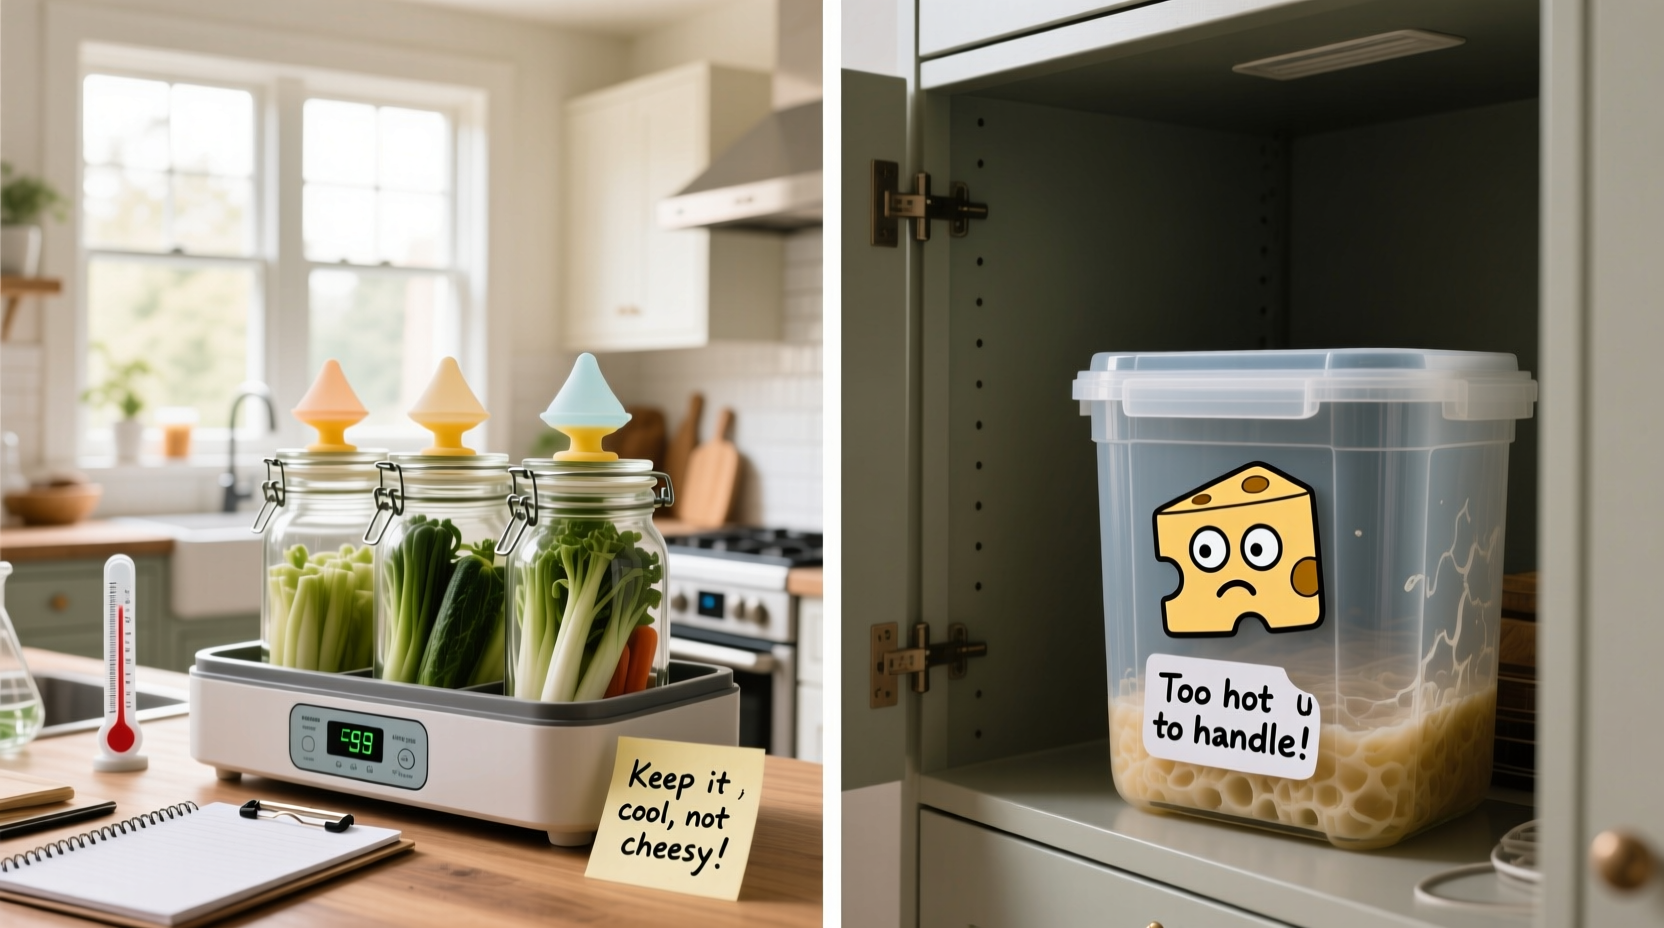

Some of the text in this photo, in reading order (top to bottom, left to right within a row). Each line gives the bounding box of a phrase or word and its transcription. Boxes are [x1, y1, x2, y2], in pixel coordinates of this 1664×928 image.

[1158, 671, 1212, 706] Too
[1222, 677, 1274, 714] hot
[1152, 710, 1310, 761] to handle!
[628, 758, 695, 801] Keep
[617, 799, 731, 831] cool, not
[620, 831, 730, 877] cheesy!
